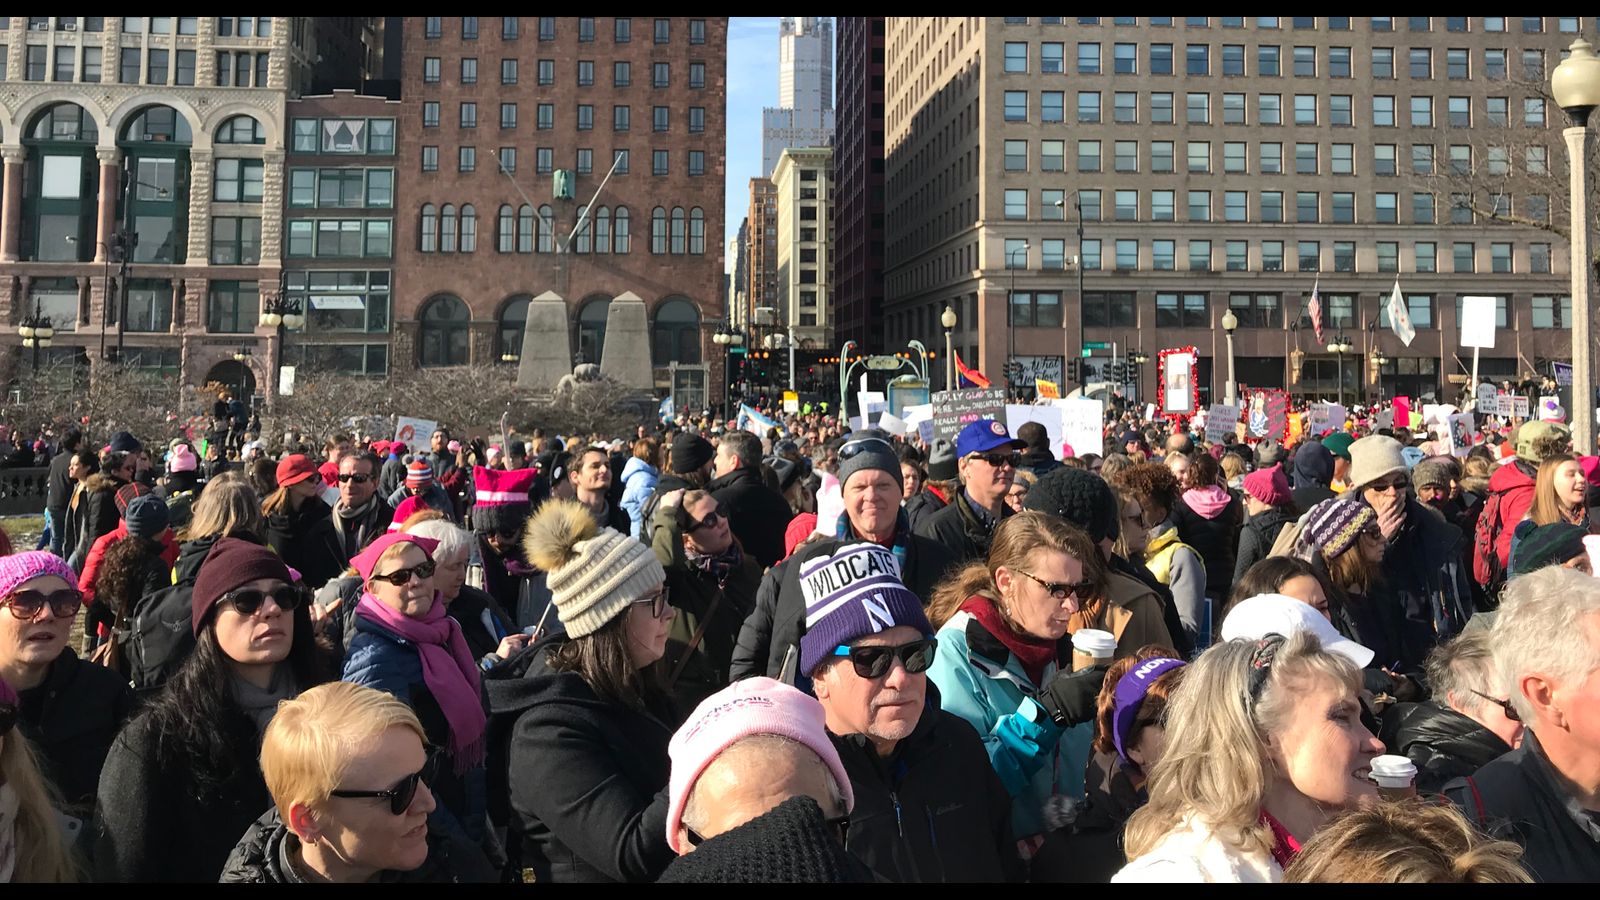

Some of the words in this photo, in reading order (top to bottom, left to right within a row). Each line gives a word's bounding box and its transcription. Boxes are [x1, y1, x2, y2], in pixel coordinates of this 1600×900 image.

[994, 389, 1004, 398] BE
[960, 413, 978, 422] MAD
[808, 551, 897, 601] WILDCATS
[861, 593, 895, 633] N
